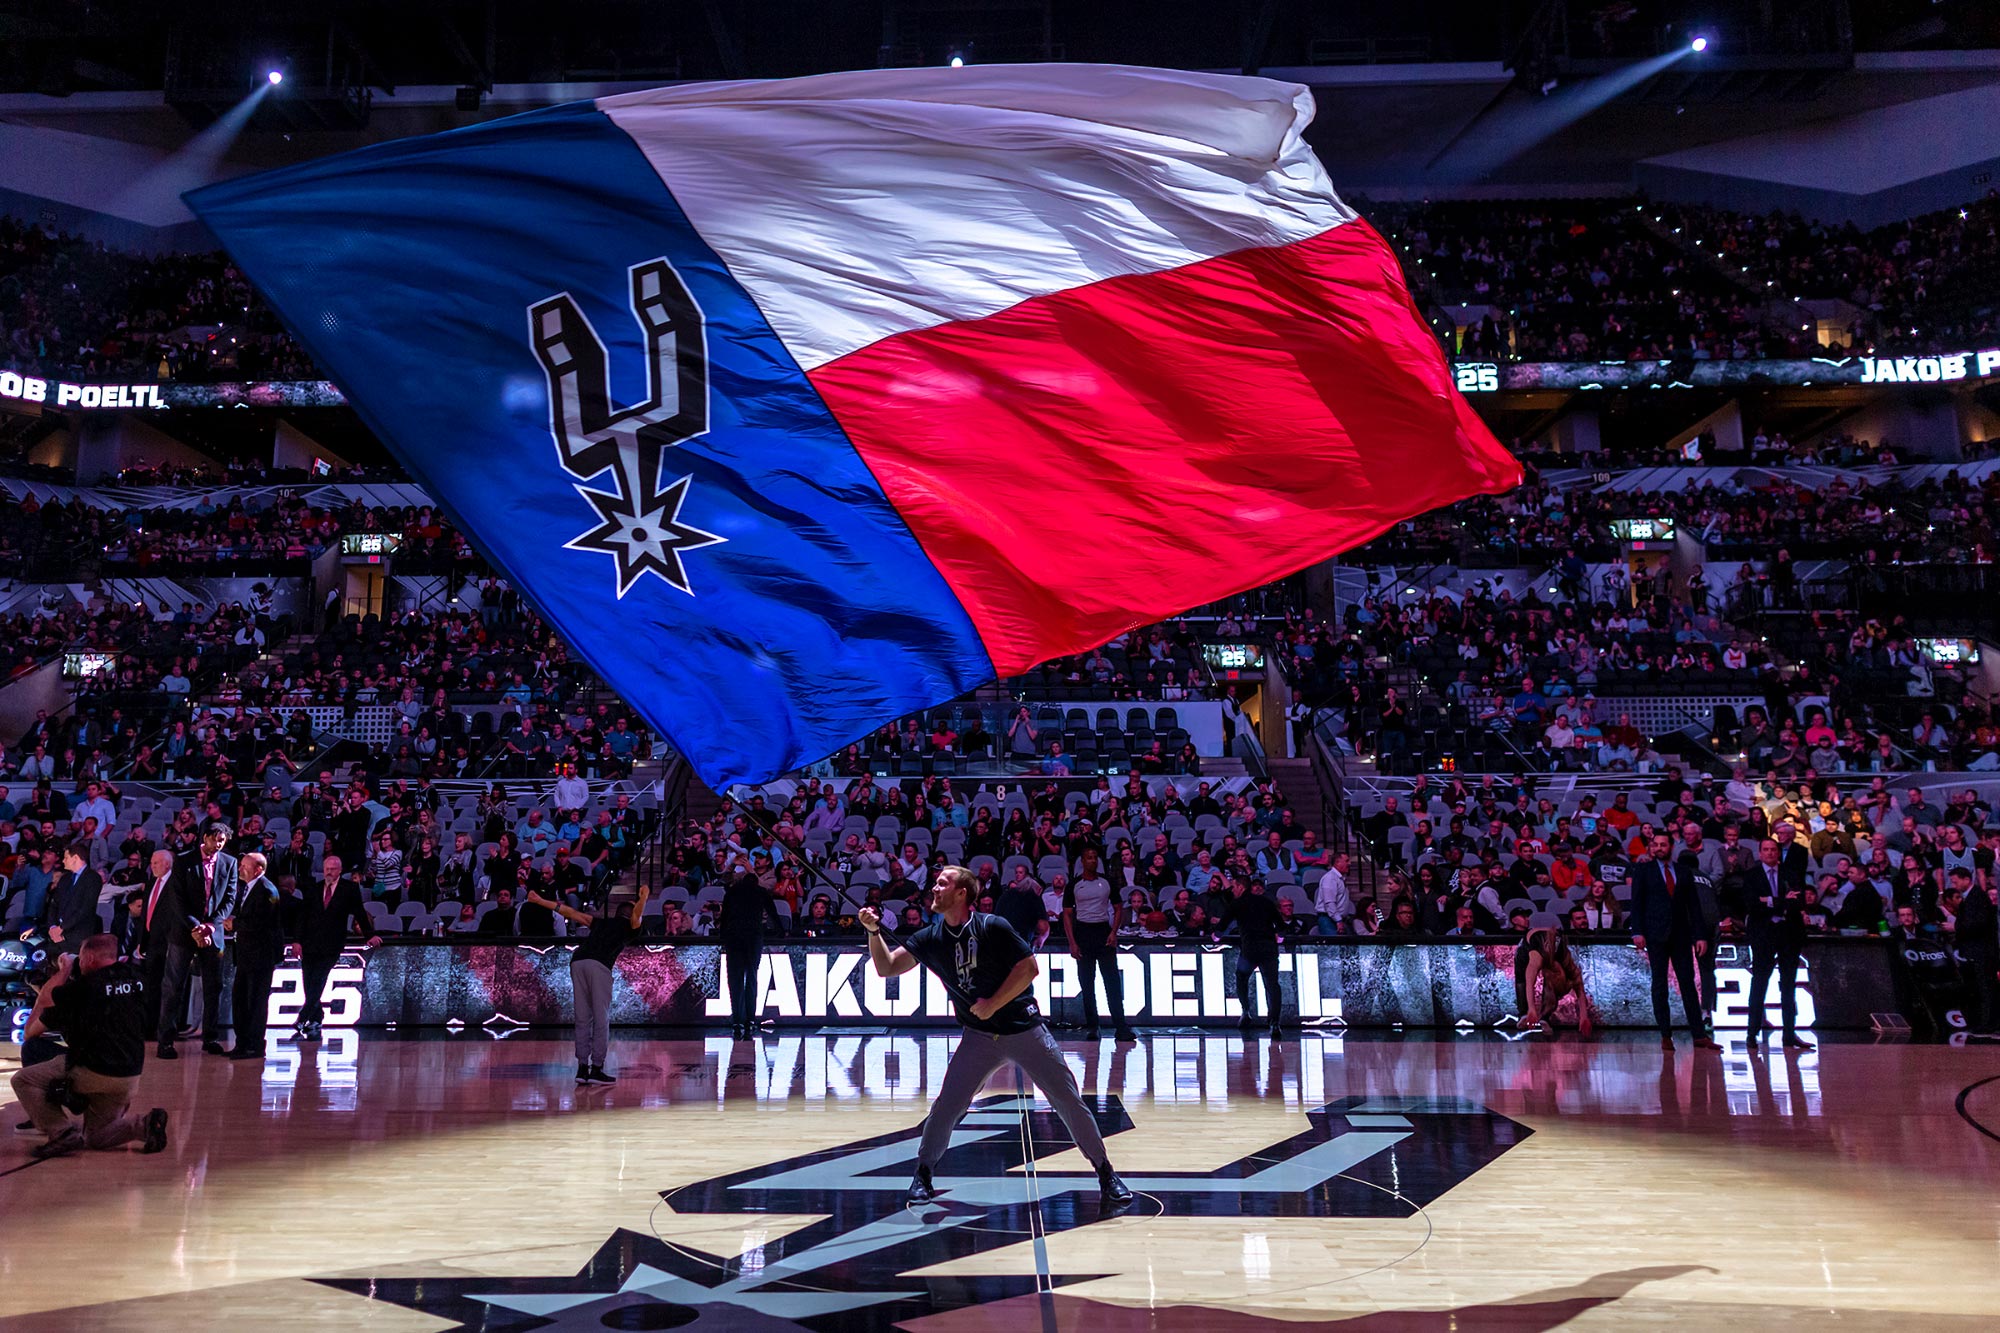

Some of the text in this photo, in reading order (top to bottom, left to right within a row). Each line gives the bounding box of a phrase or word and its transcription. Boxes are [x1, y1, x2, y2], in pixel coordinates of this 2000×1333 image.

[1860, 357, 1966, 382] JAKOB
[1457, 369, 1498, 391] 25
[57, 383, 164, 408] POELTL
[1592, 473, 1611, 483] 109
[361, 538, 382, 552] 25
[1221, 651, 1246, 667] 25
[996, 784, 1006, 801] 8
[838, 862, 852, 873] 21
[1919, 951, 1947, 960] Frost
[105, 981, 144, 996] PHOO
[705, 953, 957, 1017] JAKO
[266, 968, 364, 1025] 25
